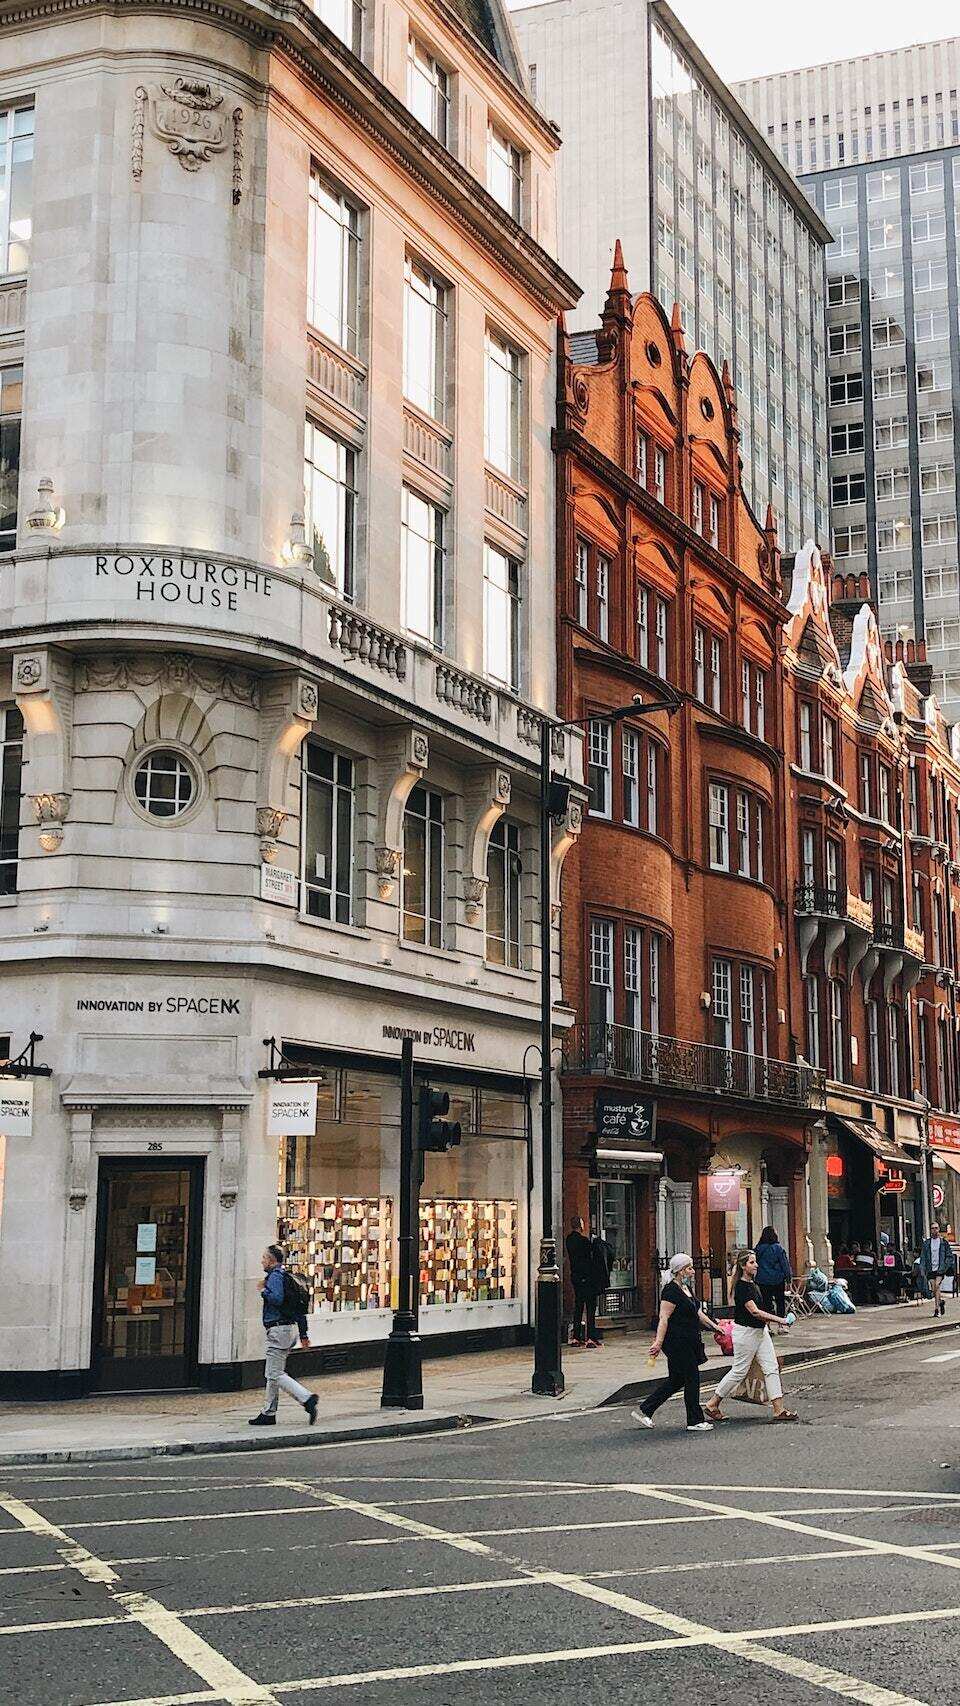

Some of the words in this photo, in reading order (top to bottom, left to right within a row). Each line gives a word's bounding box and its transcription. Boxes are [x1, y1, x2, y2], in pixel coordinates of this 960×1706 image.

[172, 108, 212, 130] 1926
[95, 555, 272, 597] ROXBURGHE
[136, 580, 238, 611] HOUSE
[264, 866, 293, 882] MARGARET
[264, 878, 284, 891] STREET
[76, 1000, 144, 1012] INNOVATION
[148, 1001, 163, 1012] BY
[166, 997, 241, 1015] SPACENK
[423, 1031, 432, 1045] BY
[603, 1104, 634, 1113] mustard
[602, 1112, 627, 1126] café
[146, 1142, 163, 1150] 285
